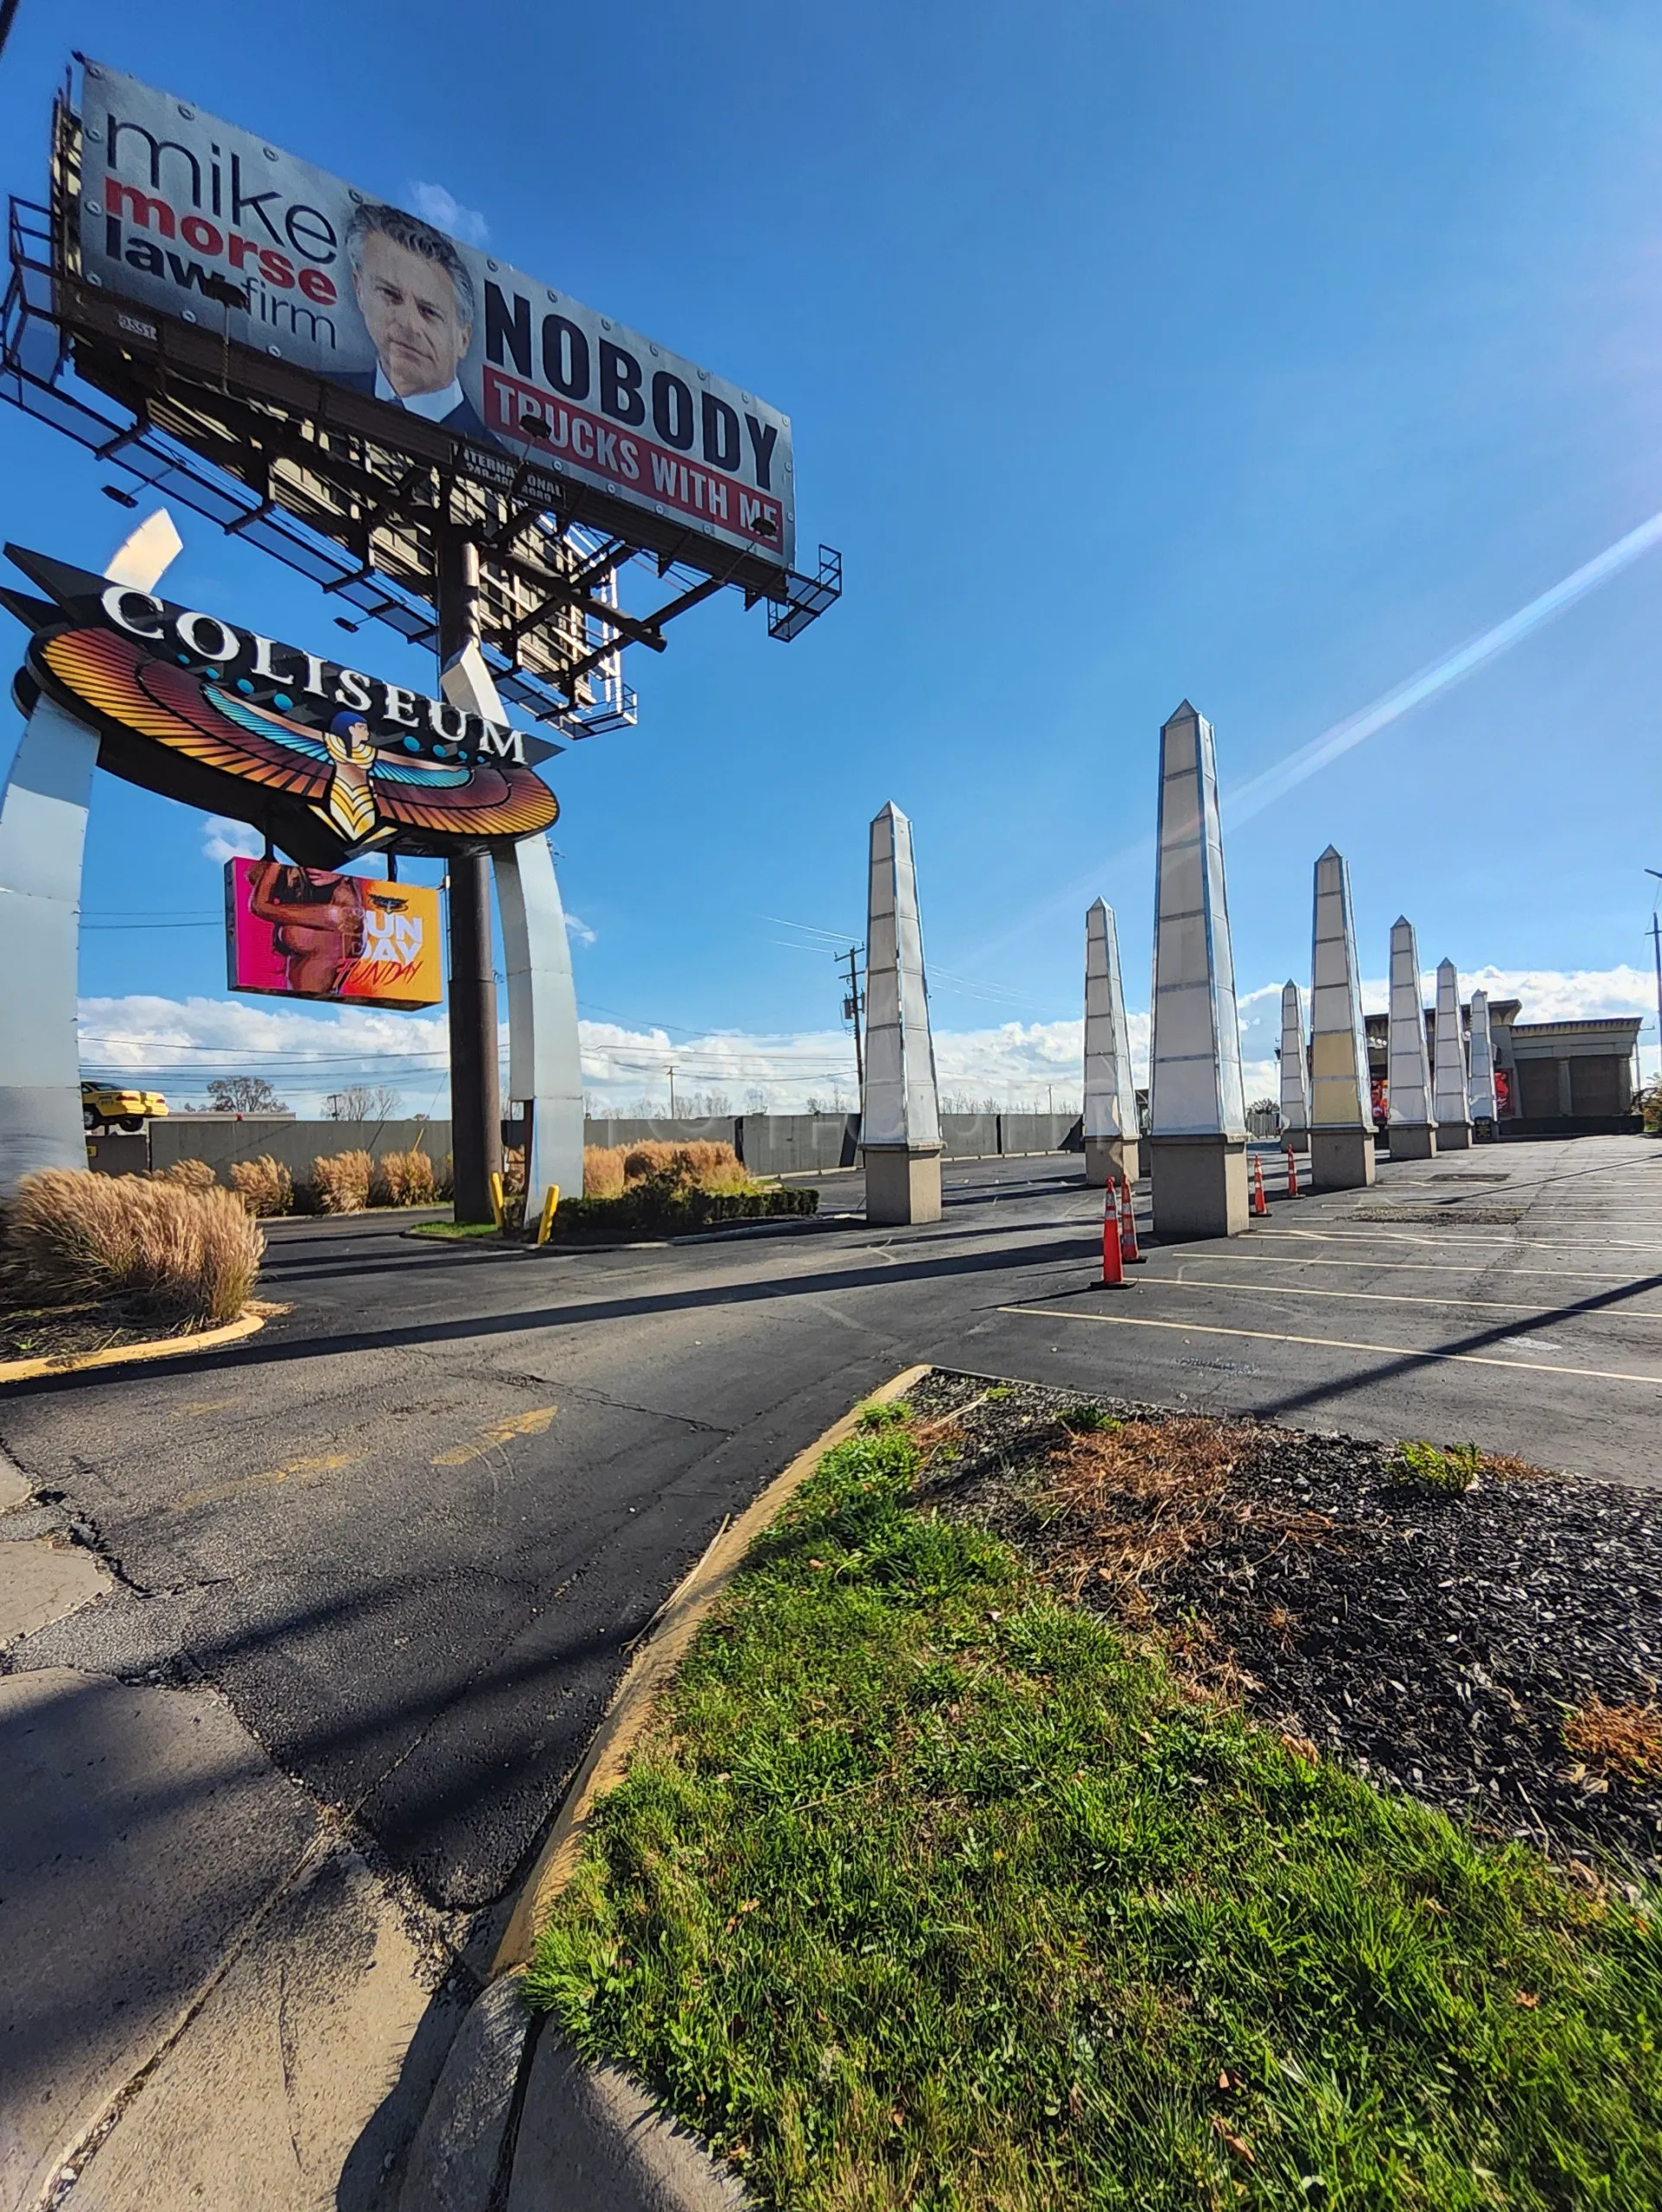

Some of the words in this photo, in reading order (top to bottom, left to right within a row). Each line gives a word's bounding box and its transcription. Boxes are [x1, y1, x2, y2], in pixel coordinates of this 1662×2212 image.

[105, 176, 338, 306] morse
[106, 113, 338, 264] mike
[105, 214, 226, 299] law
[240, 276, 336, 350] firm
[484, 279, 779, 493] NOBODY
[650, 451, 728, 520] WITH
[101, 585, 527, 766] COLISEUM
